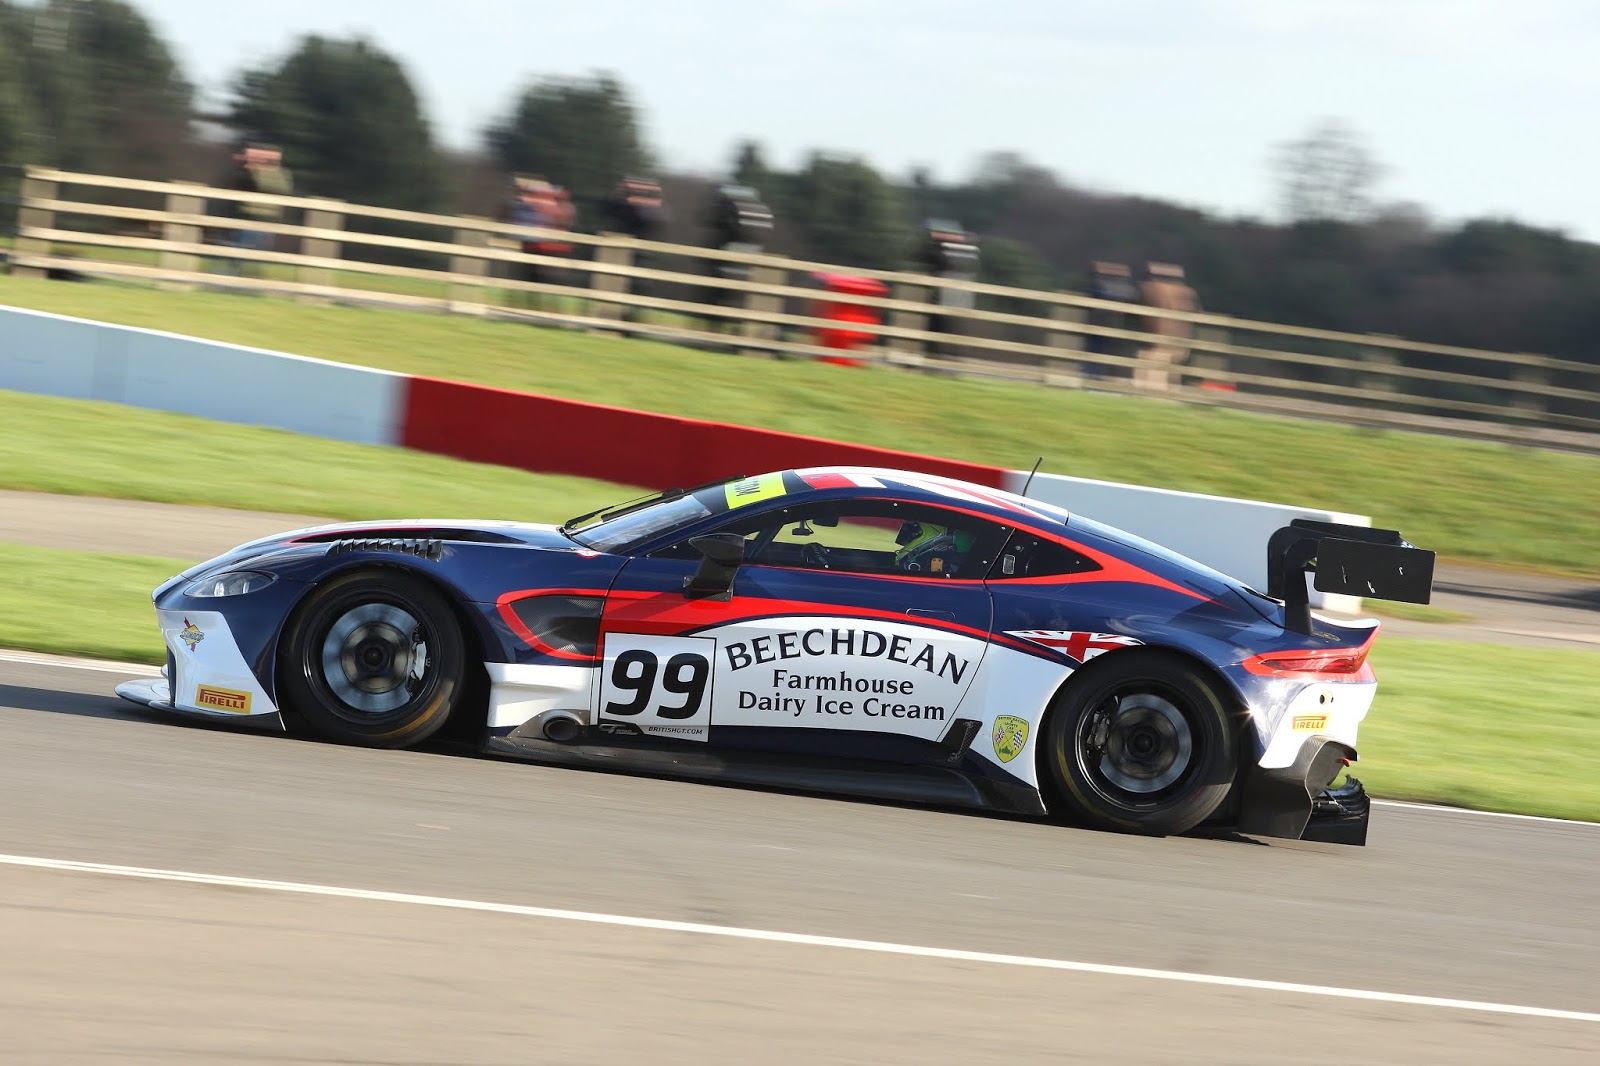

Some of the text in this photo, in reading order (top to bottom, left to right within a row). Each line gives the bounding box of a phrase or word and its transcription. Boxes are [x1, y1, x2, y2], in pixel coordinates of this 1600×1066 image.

[725, 628, 969, 685] BEECHDEAN
[605, 649, 710, 719] 99
[772, 669, 914, 695] Farmhouse
[199, 688, 247, 709] PIRELLI
[738, 691, 945, 720] Dairy Ice Cream
[648, 726, 703, 735] BRITISHGT.COM
[1292, 715, 1327, 729] PIRELLI
